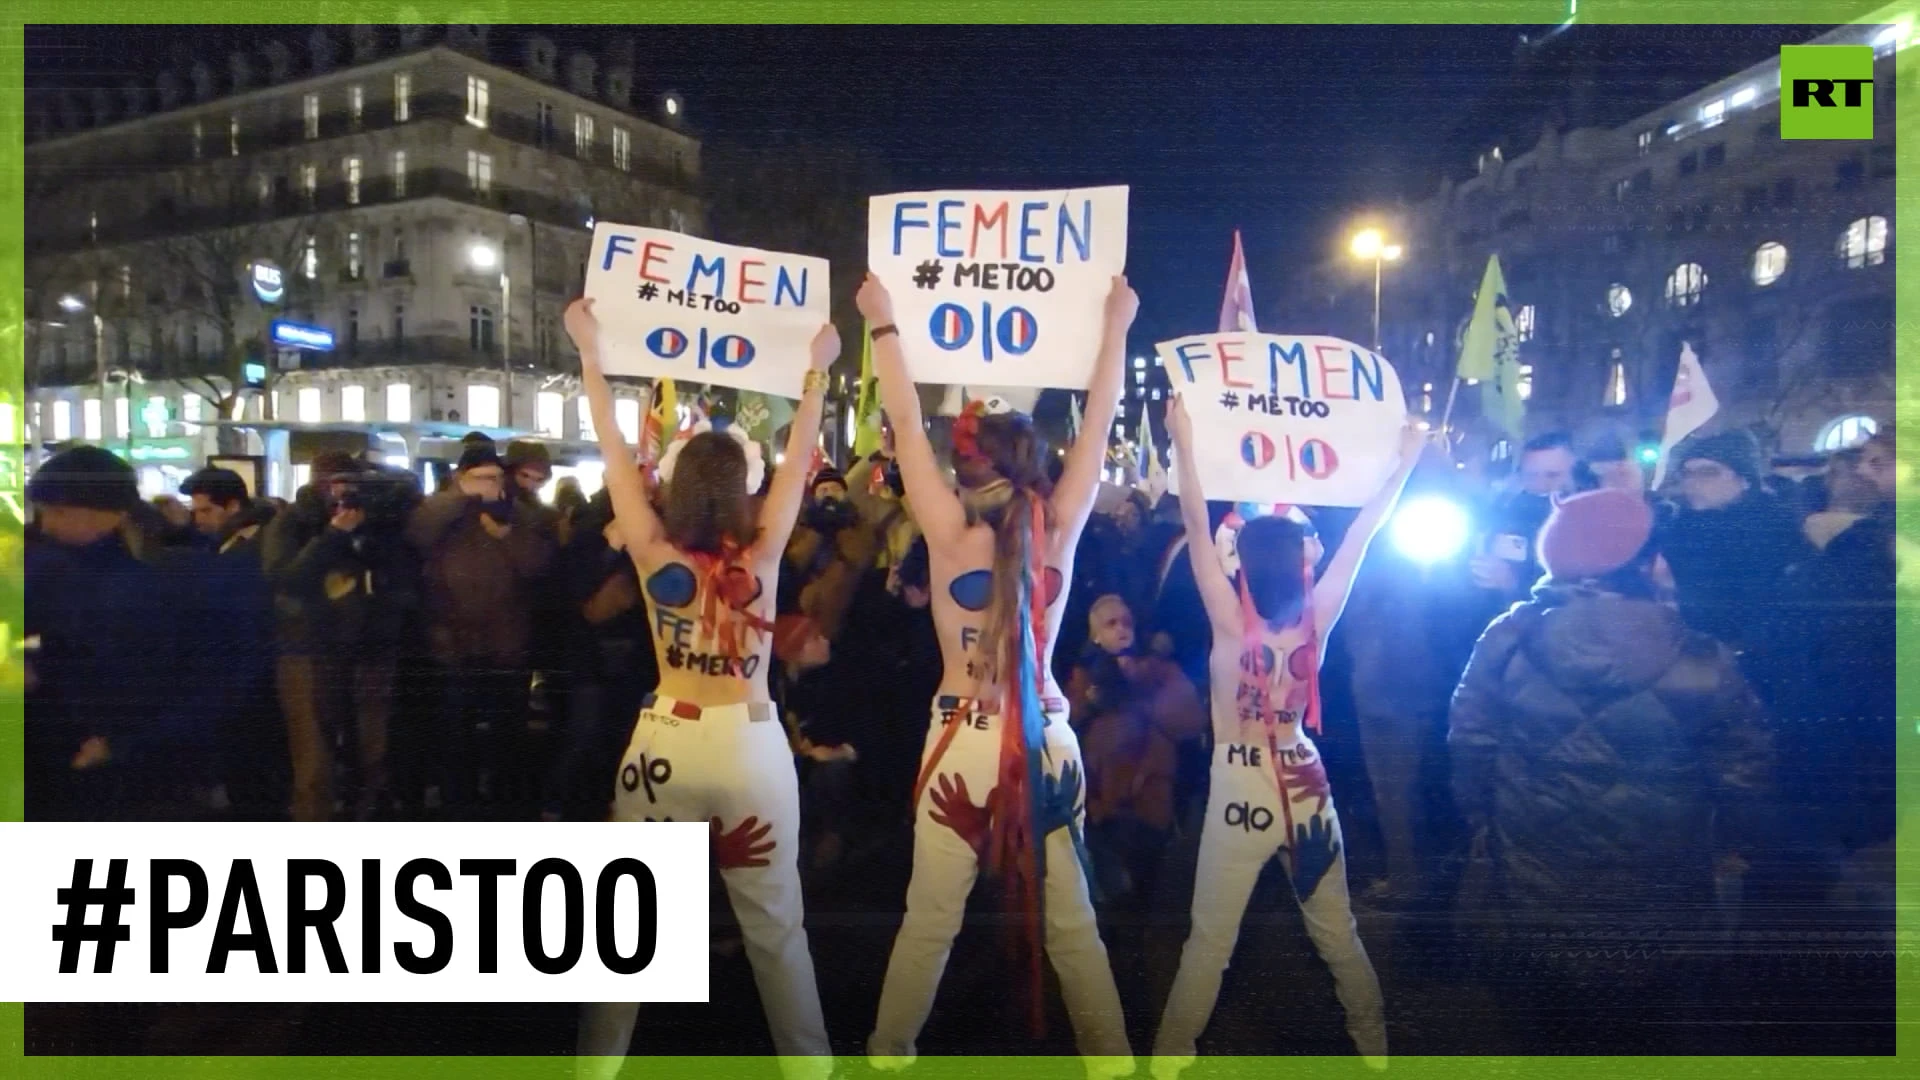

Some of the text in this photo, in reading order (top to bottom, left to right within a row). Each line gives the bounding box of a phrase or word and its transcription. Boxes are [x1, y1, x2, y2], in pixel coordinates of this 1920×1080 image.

[890, 199, 1092, 264] FEMEN
[602, 235, 808, 307] FEMEN
[1176, 341, 1385, 402] FEMEN
